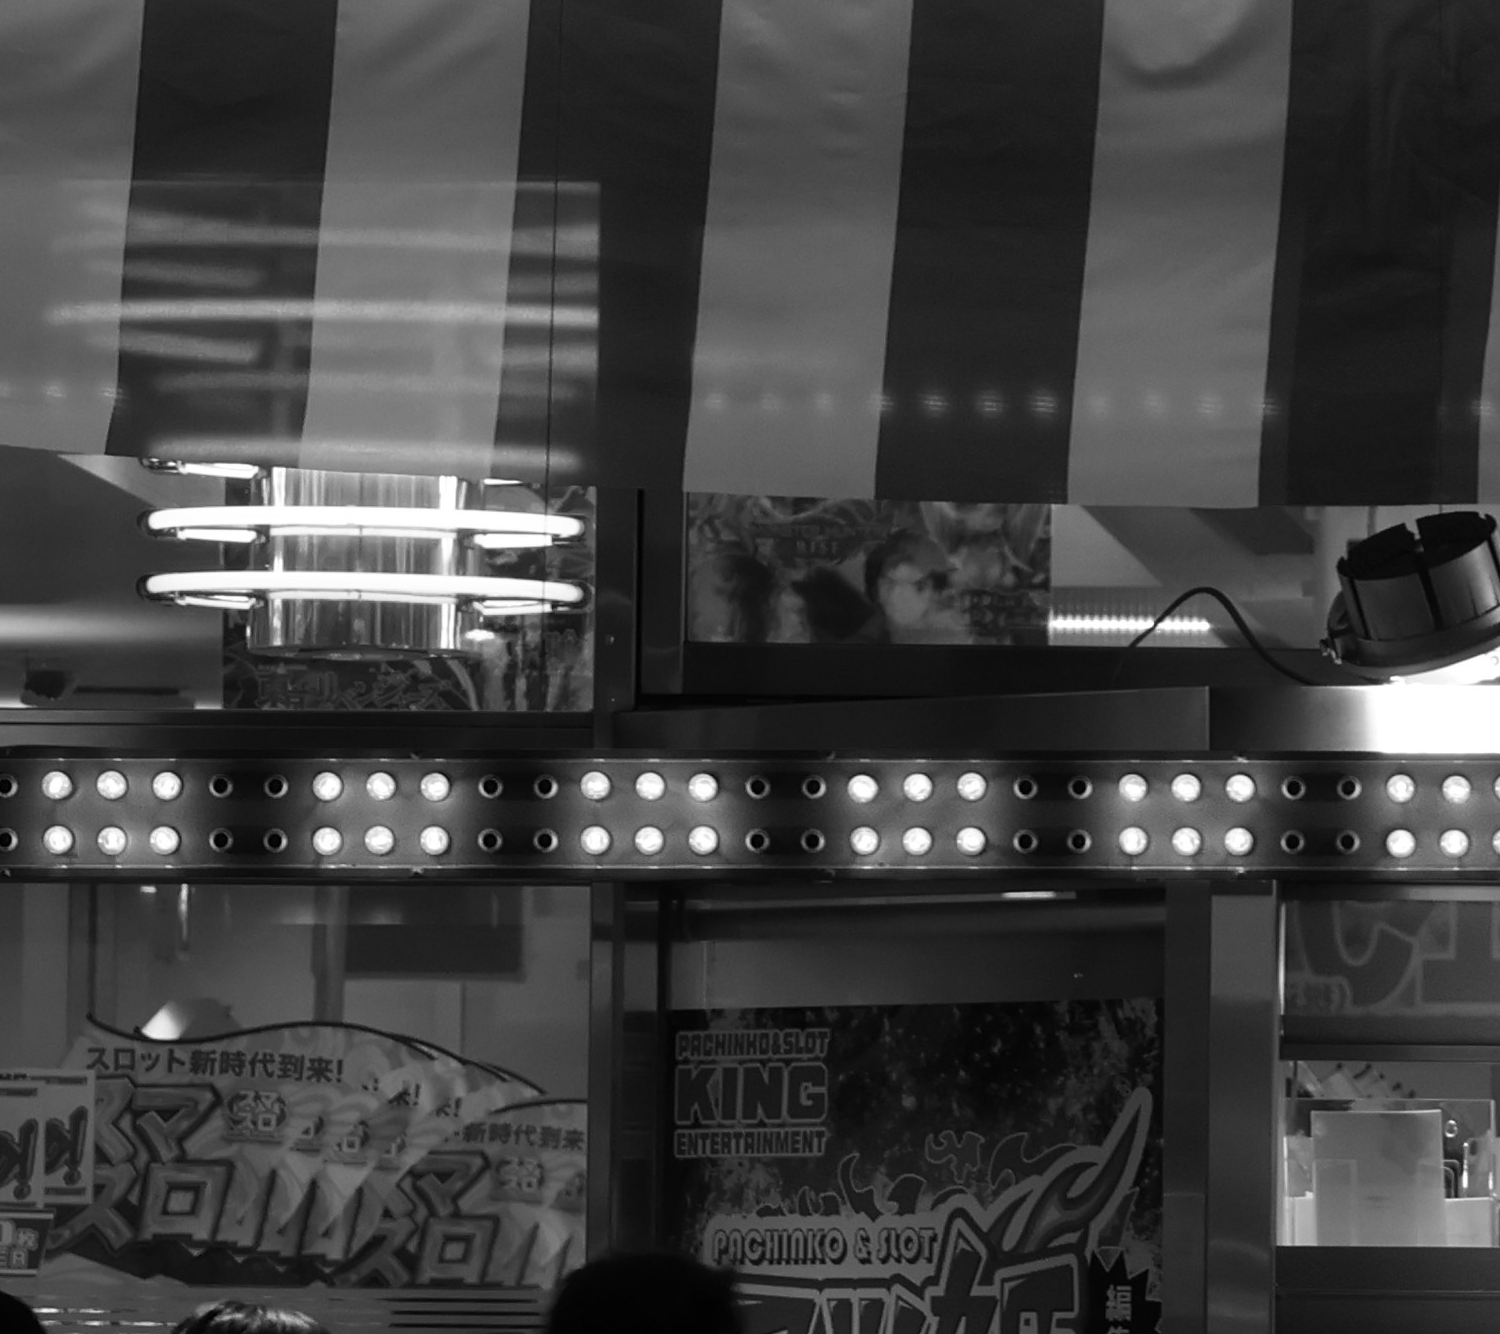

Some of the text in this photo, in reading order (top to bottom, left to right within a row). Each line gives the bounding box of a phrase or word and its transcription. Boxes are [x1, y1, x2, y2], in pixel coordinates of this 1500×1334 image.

[86, 1045, 345, 1083] スロット新時代到来!
[674, 1061, 829, 1125] KING
[462, 1121, 584, 1152] 新時代到来
[673, 1126, 829, 1158] ENTERTAINMENT
[713, 1227, 940, 1267] PACHINKO & SLOT
